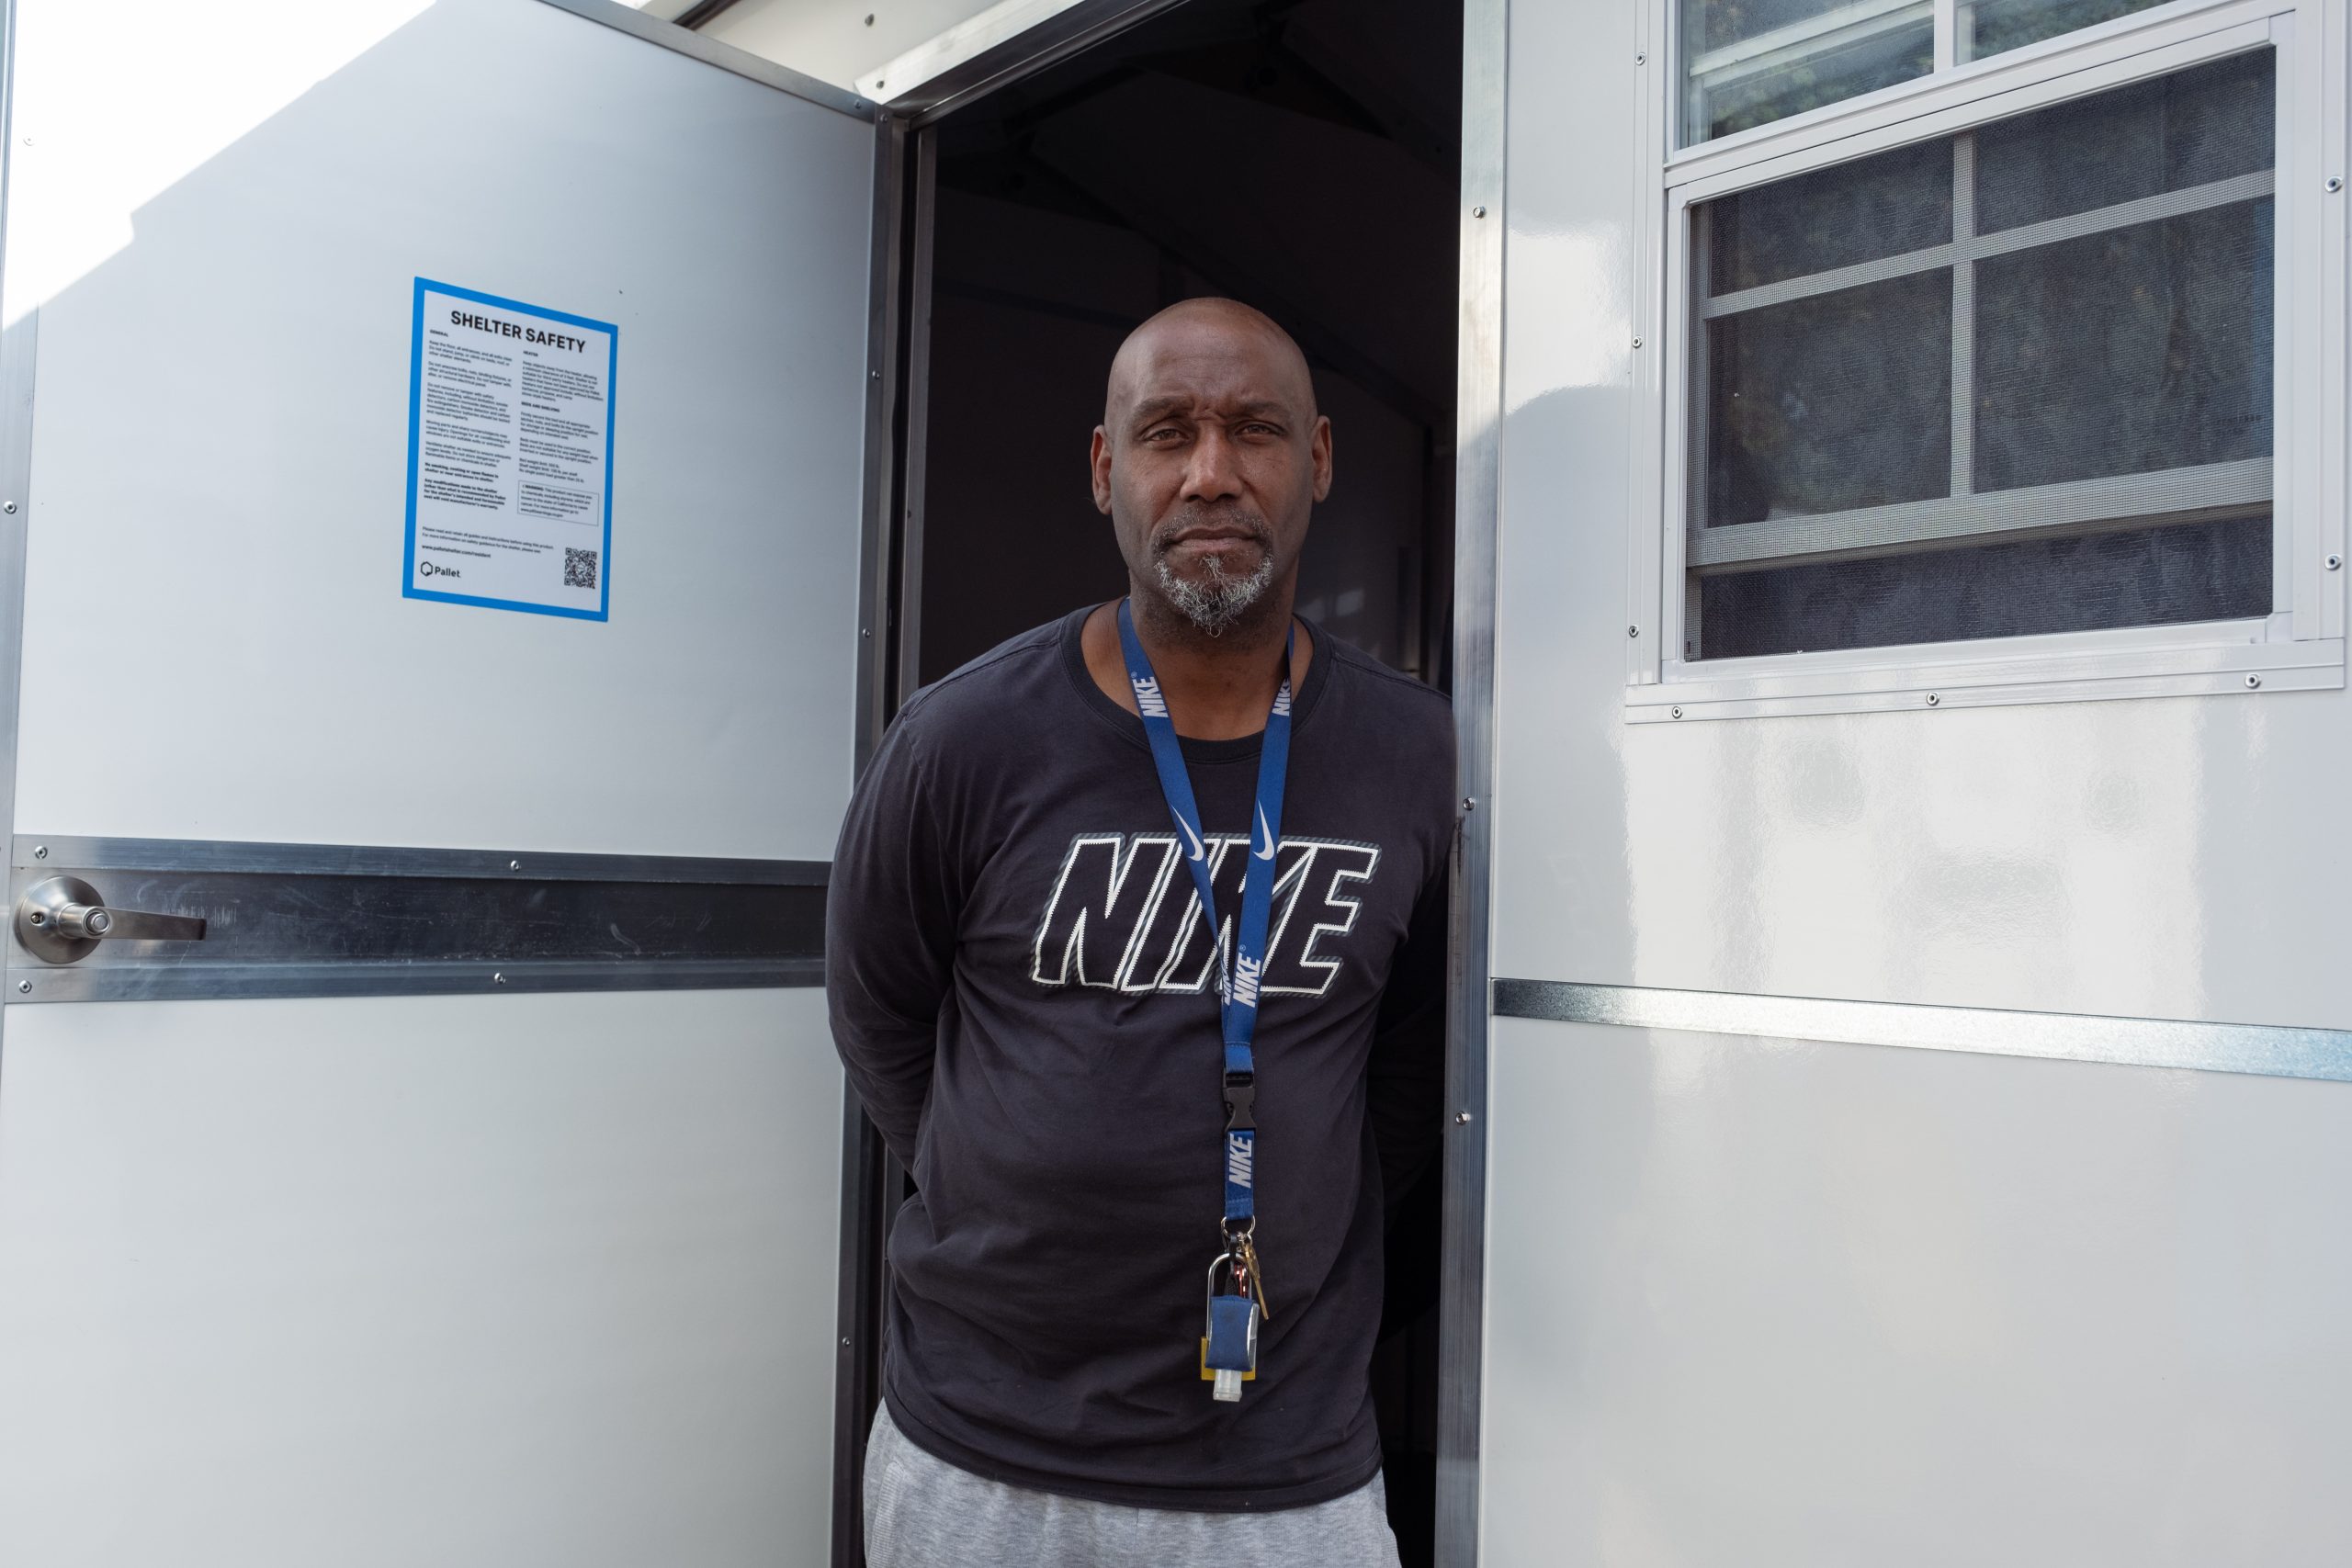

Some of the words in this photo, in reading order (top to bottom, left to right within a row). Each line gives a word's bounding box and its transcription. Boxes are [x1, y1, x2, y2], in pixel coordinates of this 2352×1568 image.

[450, 310, 522, 340] SHELTER
[526, 328, 586, 354] SAFETY
[435, 566, 460, 578] Pallet
[1132, 676, 1169, 717] NIKE
[1030, 833, 1382, 999] NIKE
[1233, 952, 1261, 1009] NIKE
[1228, 1133, 1252, 1189] NIKE
